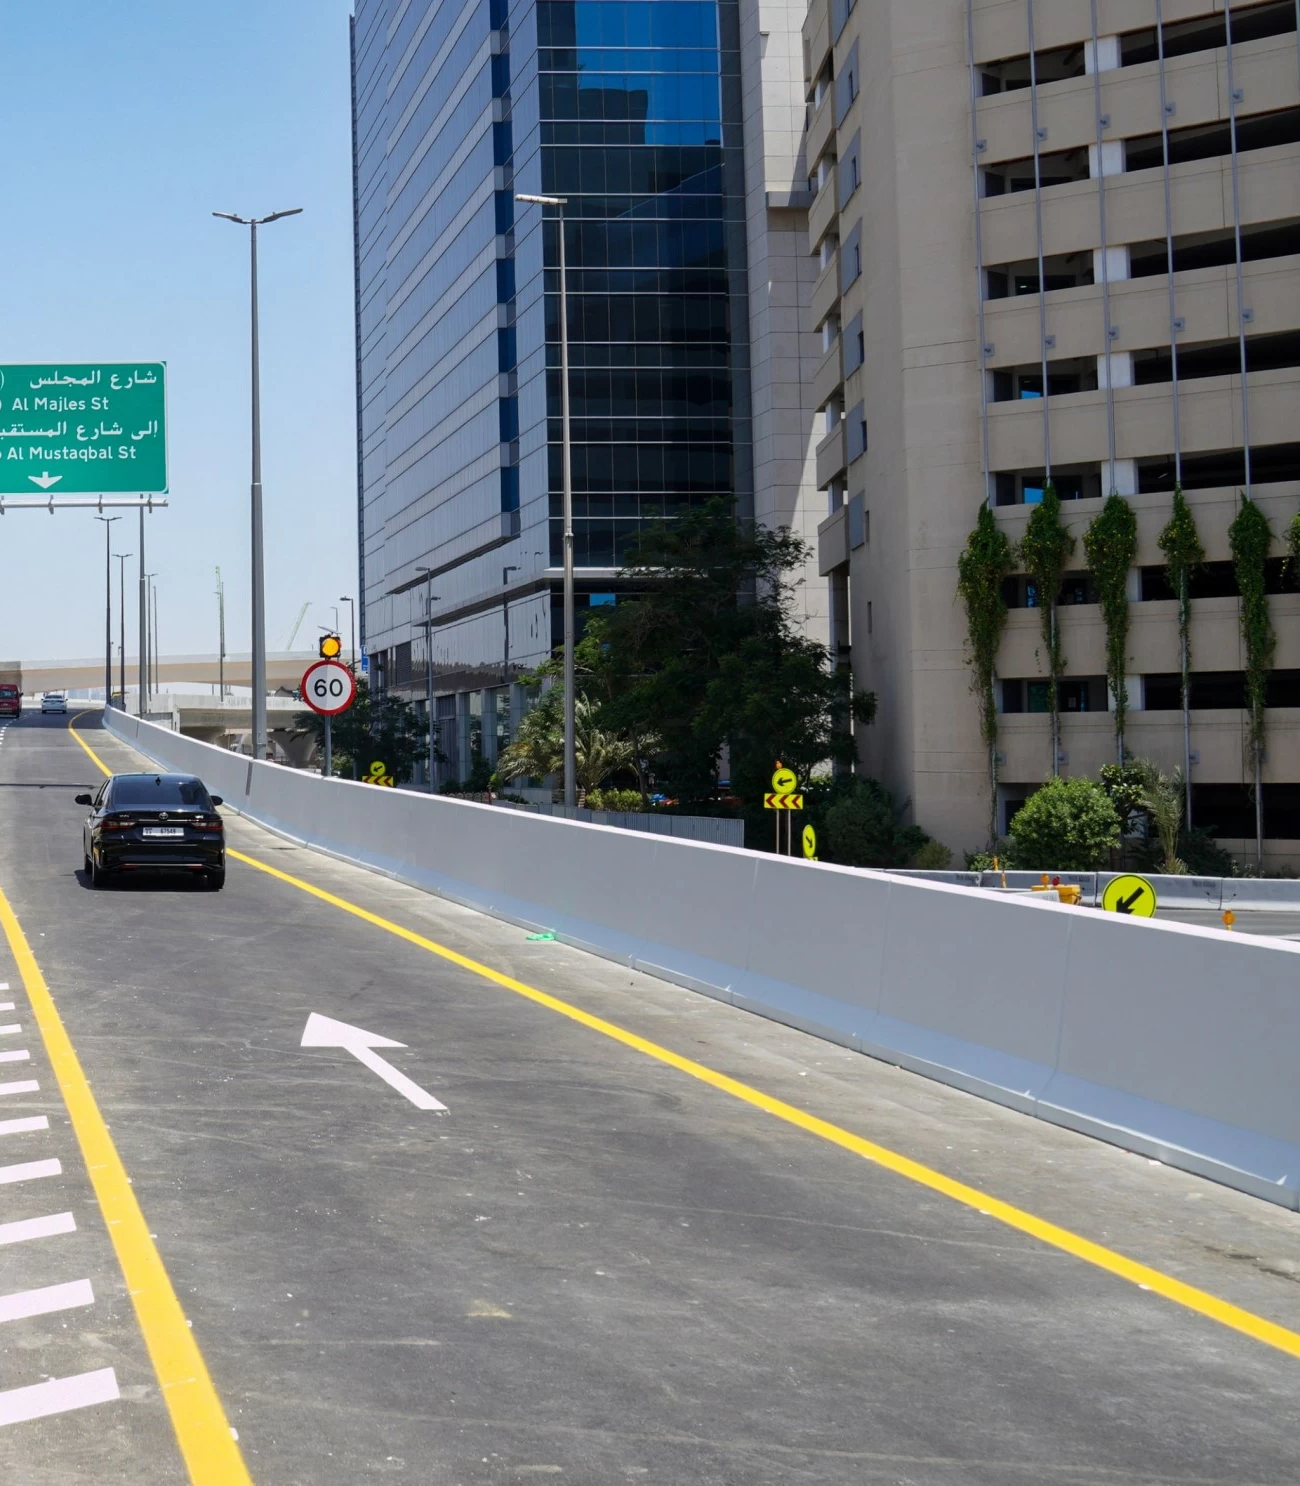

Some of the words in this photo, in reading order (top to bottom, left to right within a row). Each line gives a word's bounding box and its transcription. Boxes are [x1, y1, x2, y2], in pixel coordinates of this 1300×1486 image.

[30, 370, 100, 388] المجلس
[110, 370, 157, 390] شارع
[12, 398, 28, 410] Al
[34, 397, 86, 412] Majles
[91, 398, 108, 410] St
[76, 422, 123, 441] شارع
[7, 447, 24, 460] Al
[30, 446, 113, 462] Mustaqbal
[118, 446, 136, 459] St
[314, 679, 343, 697] 60
